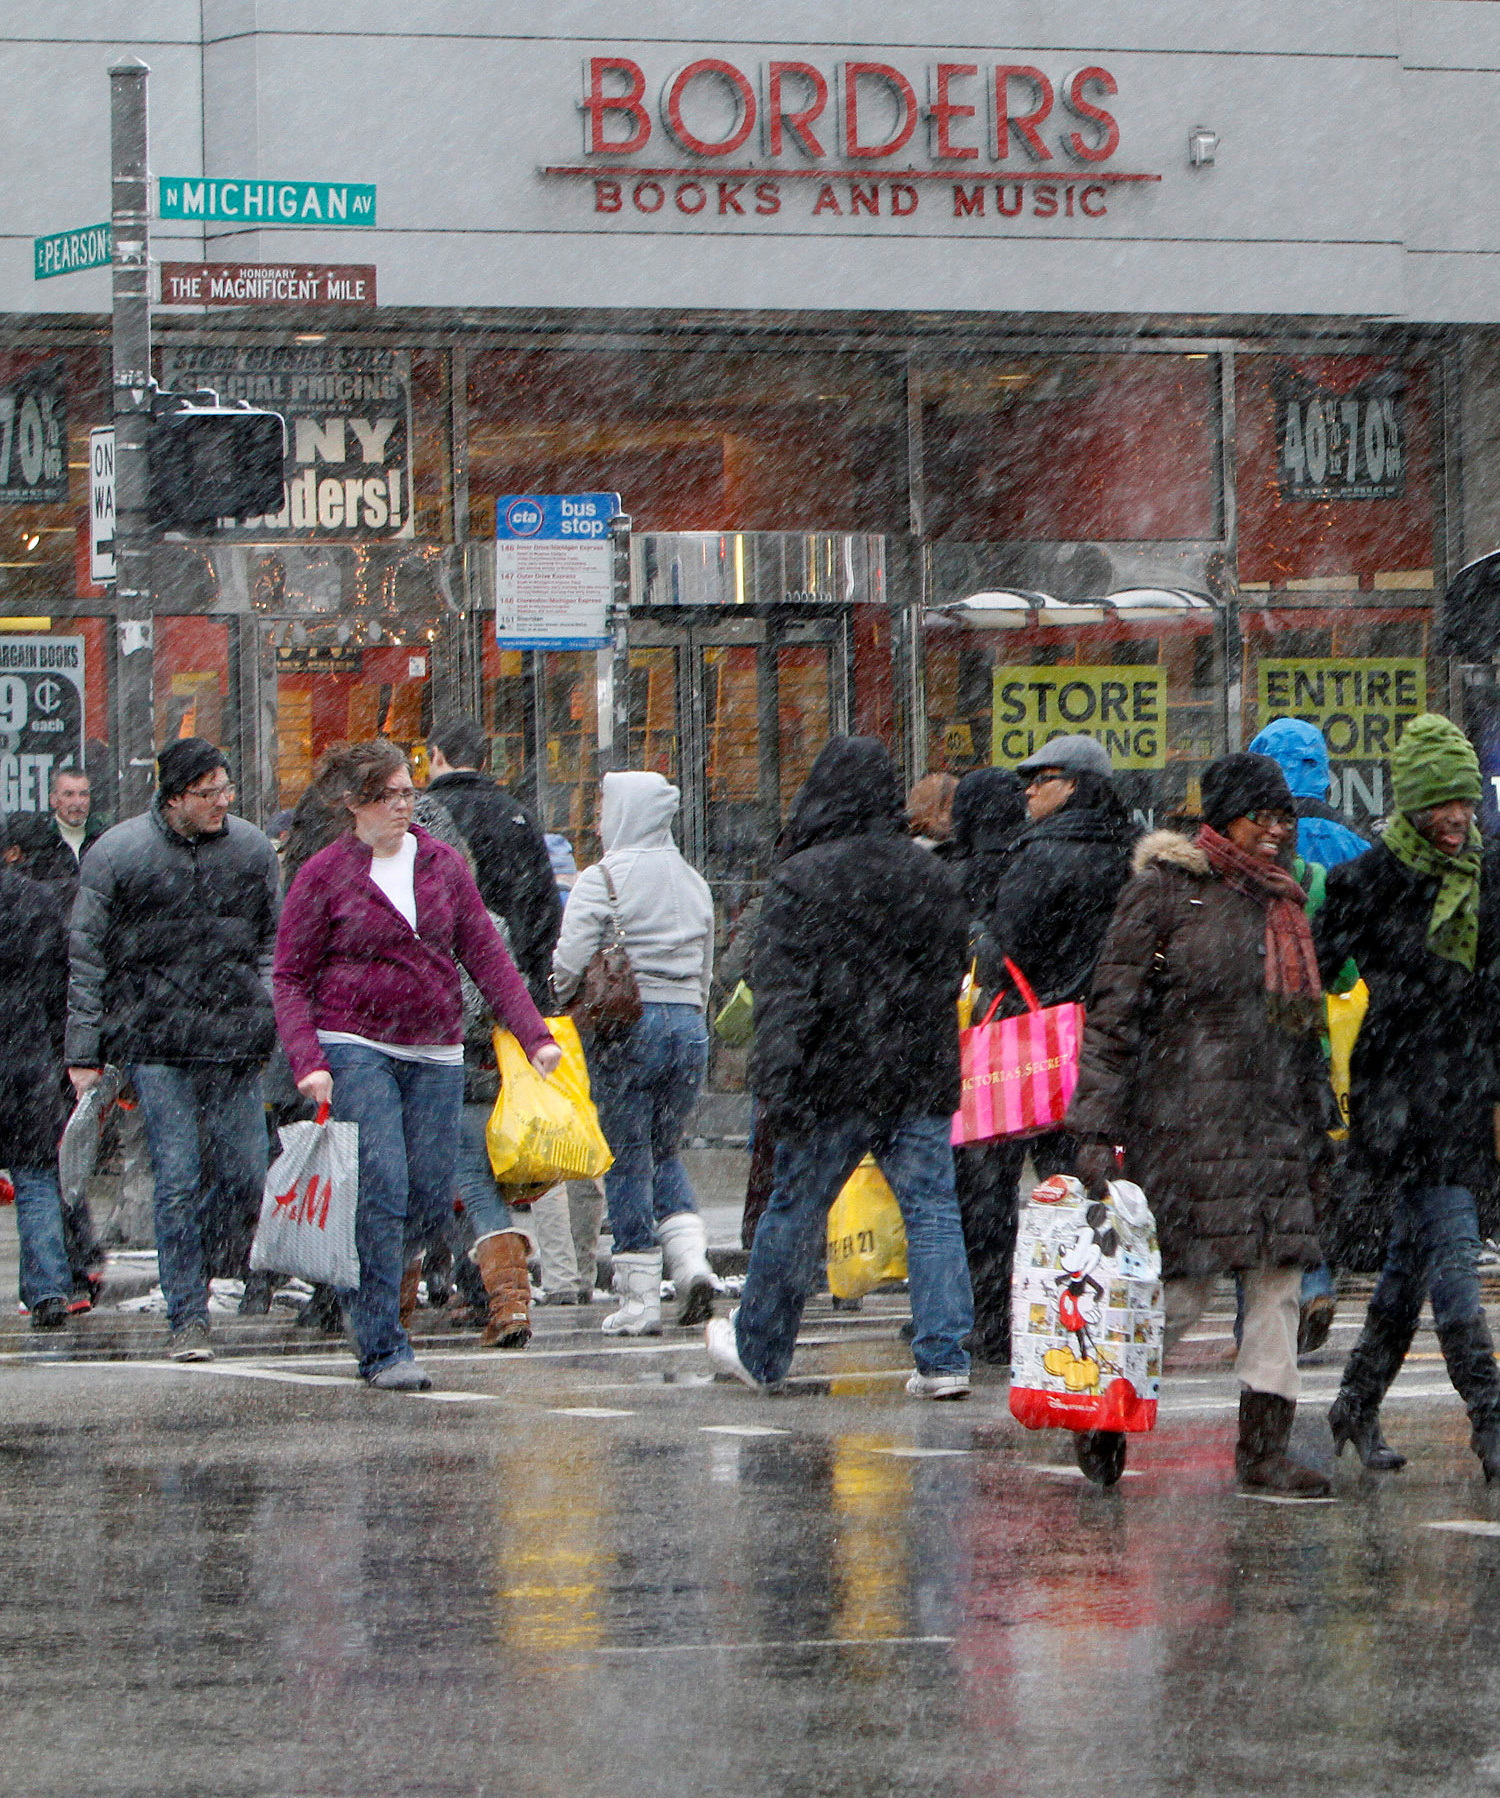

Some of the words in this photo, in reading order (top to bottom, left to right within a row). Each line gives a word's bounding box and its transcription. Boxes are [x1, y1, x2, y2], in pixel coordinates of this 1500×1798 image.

[580, 56, 1121, 164] BORDERS
[166, 187, 178, 207] N
[183, 181, 348, 220] MICHIGAN
[352, 194, 373, 215] AV
[595, 179, 783, 216] BOOKS
[812, 184, 921, 218] AND
[953, 184, 1110, 219] MUSIC
[44, 229, 107, 273] PEARSON
[170, 276, 202, 298] THE
[211, 277, 320, 301] MAGNIFICENT
[327, 280, 366, 301] MILE
[239, 268, 297, 280] HONORARY
[286, 416, 399, 464] NY
[94, 444, 114, 478] ON
[94, 484, 115, 520] WA
[216, 469, 402, 529] ders!
[560, 499, 598, 517] bus
[512, 510, 539, 524] cta
[560, 517, 604, 538] stop
[0, 644, 38, 669] RGAIN
[39, 644, 79, 668] BOOKS
[1000, 680, 1159, 724] STORE
[1266, 669, 1418, 708] ENTIRE
[31, 718, 65, 733] each
[1001, 728, 1158, 759] CLNG
[0, 753, 54, 813] GET
[1024, 1053, 1070, 1077] SECRET
[857, 1229, 875, 1254] 21
